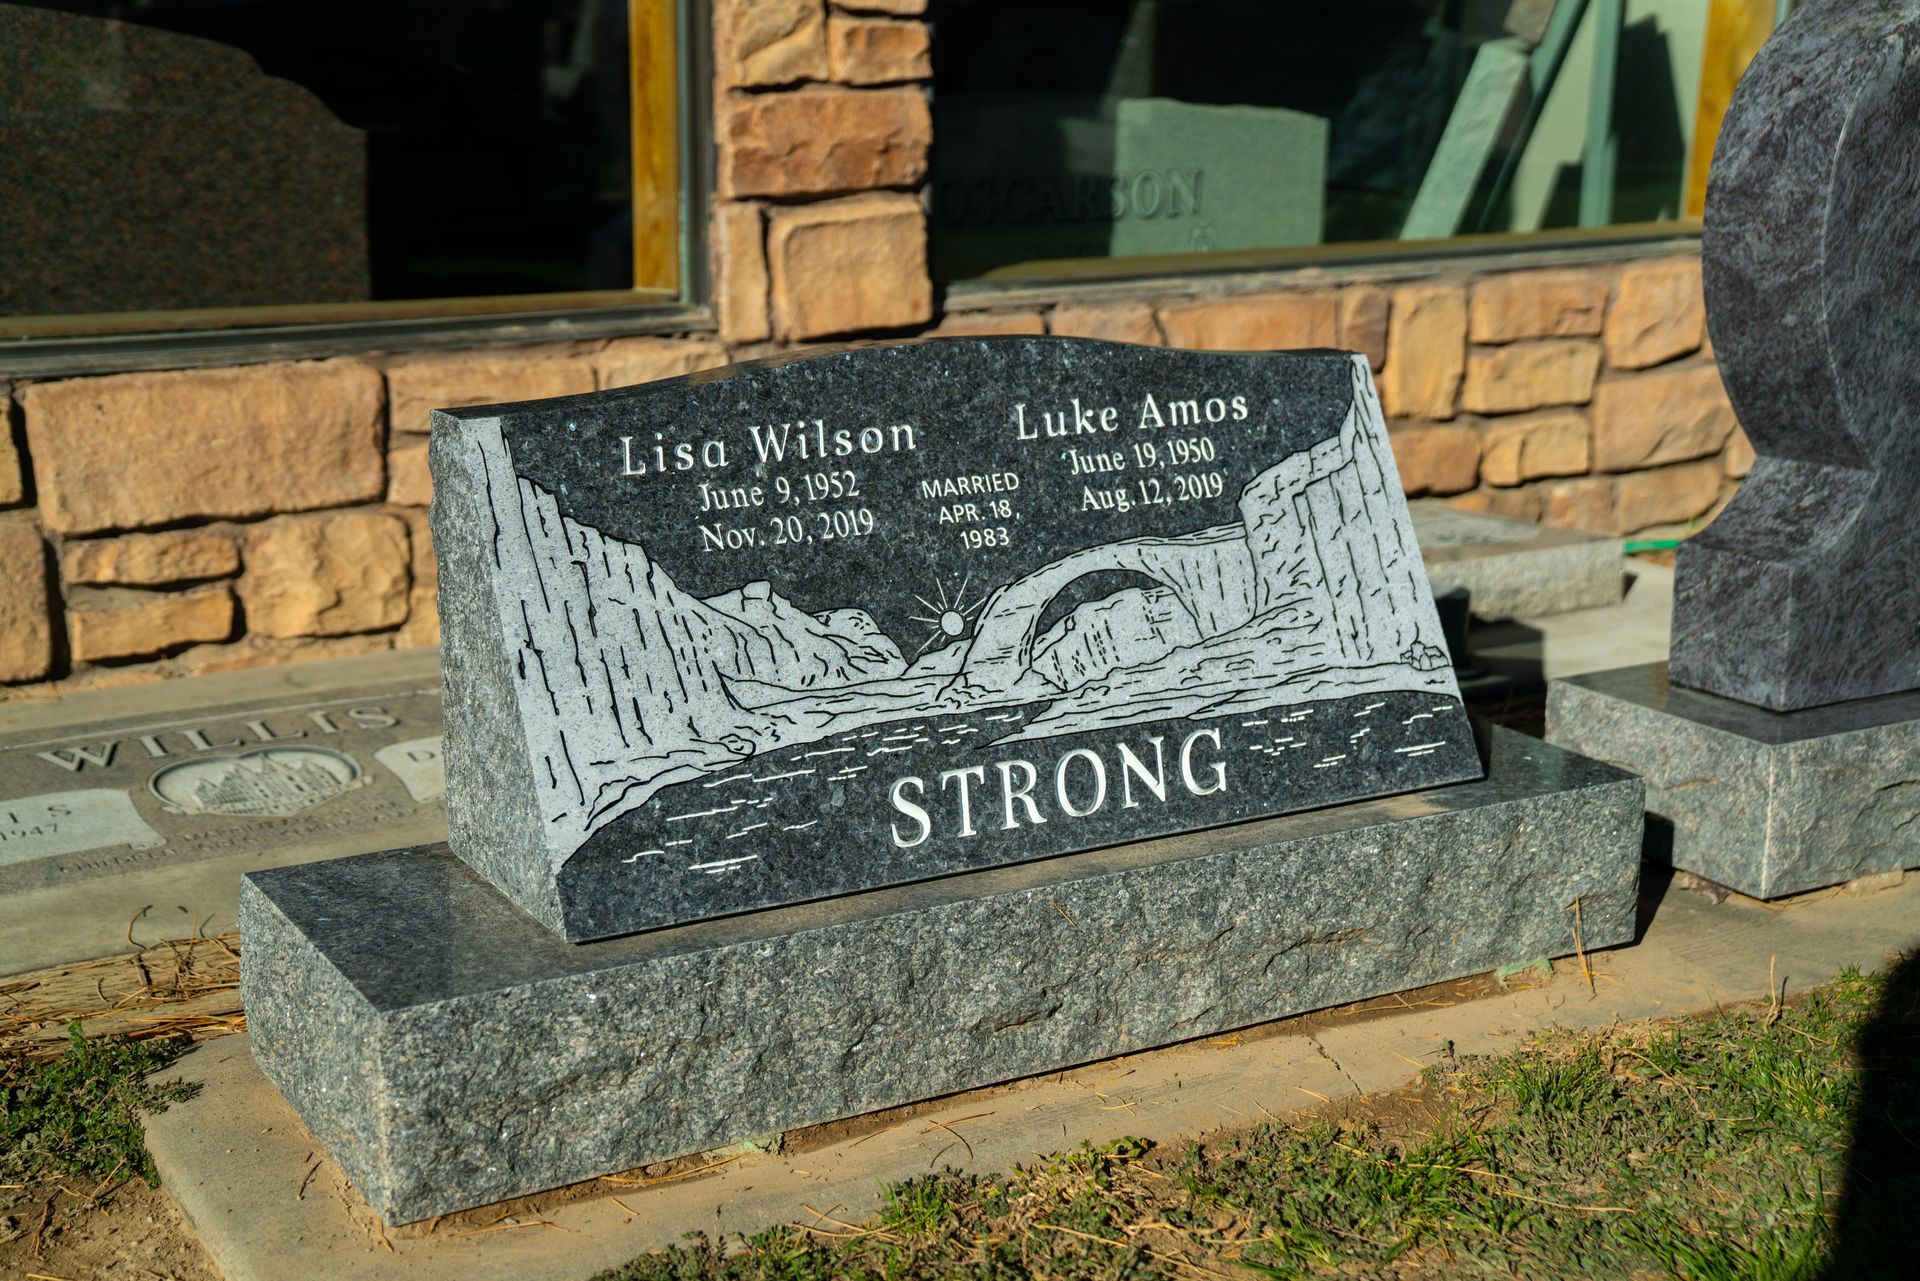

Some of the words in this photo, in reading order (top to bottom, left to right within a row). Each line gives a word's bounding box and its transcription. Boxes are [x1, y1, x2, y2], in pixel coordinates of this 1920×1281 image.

[1015, 397, 1119, 440] Luke
[1138, 392, 1249, 430] Amos
[619, 431, 730, 476] Lisa
[750, 418, 917, 464] Wilson
[1068, 449, 1126, 476] June
[698, 481, 765, 513] June
[921, 472, 1020, 499] MARRIED
[1081, 485, 1136, 513] Aug.
[1137, 477, 1172, 506] 12,
[1173, 471, 1224, 502] 2019
[698, 522, 766, 552] Nov.
[769, 515, 814, 546] 20,
[817, 507, 874, 540] 2019
[939, 502, 986, 525] APR.
[988, 499, 1021, 520] 18,
[960, 527, 1010, 550] 1983
[34, 706, 403, 773] WILLIS
[888, 727, 1228, 848] STRONG
